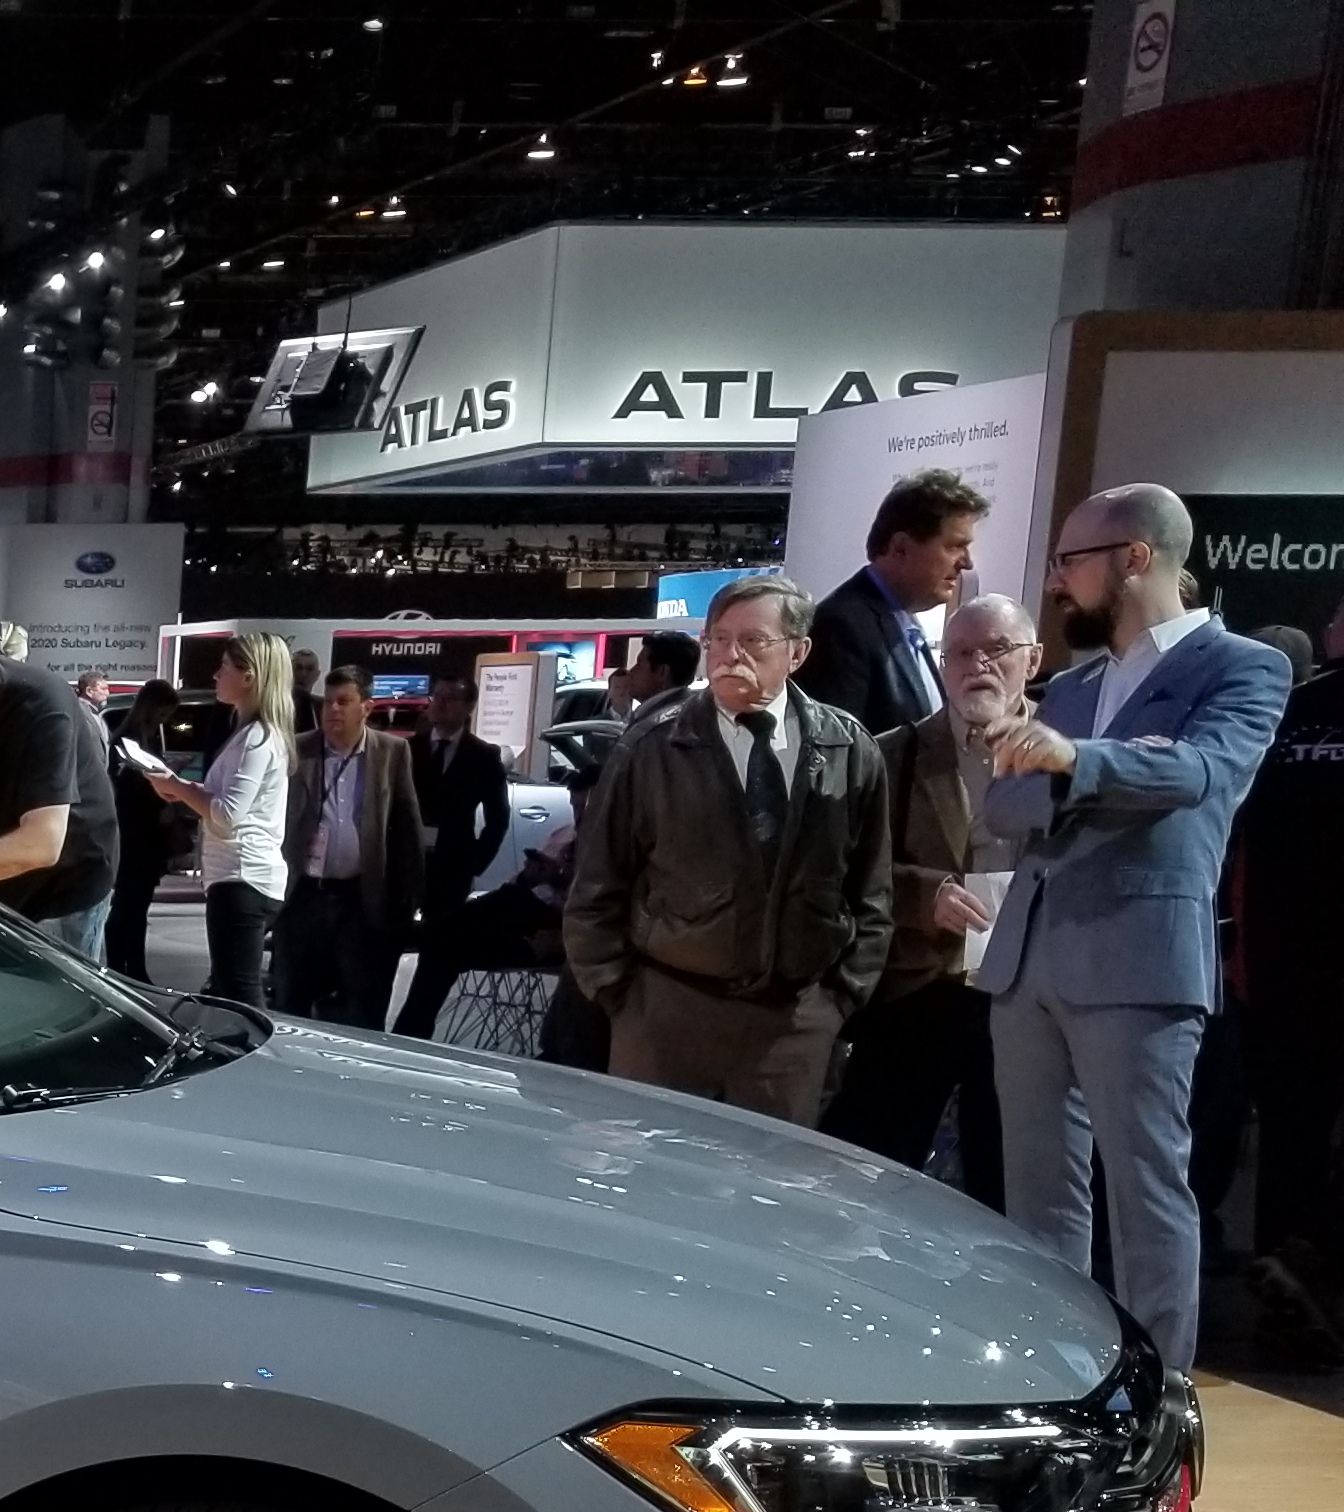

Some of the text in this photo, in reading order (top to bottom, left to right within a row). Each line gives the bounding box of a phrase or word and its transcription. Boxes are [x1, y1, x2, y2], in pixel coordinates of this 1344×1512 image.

[379, 379, 513, 453] ATLAS
[888, 419, 1009, 453] We're positively thrilled.
[63, 578, 125, 588] SUBARU
[93, 623, 111, 633] the
[113, 623, 151, 633] all-new
[30, 638, 57, 648] 2020
[62, 637, 102, 649] Subaru
[372, 643, 441, 656] HYUNDAI
[47, 662, 60, 672] for
[63, 663, 75, 672] all
[77, 663, 92, 672] the
[95, 663, 118, 674] right
